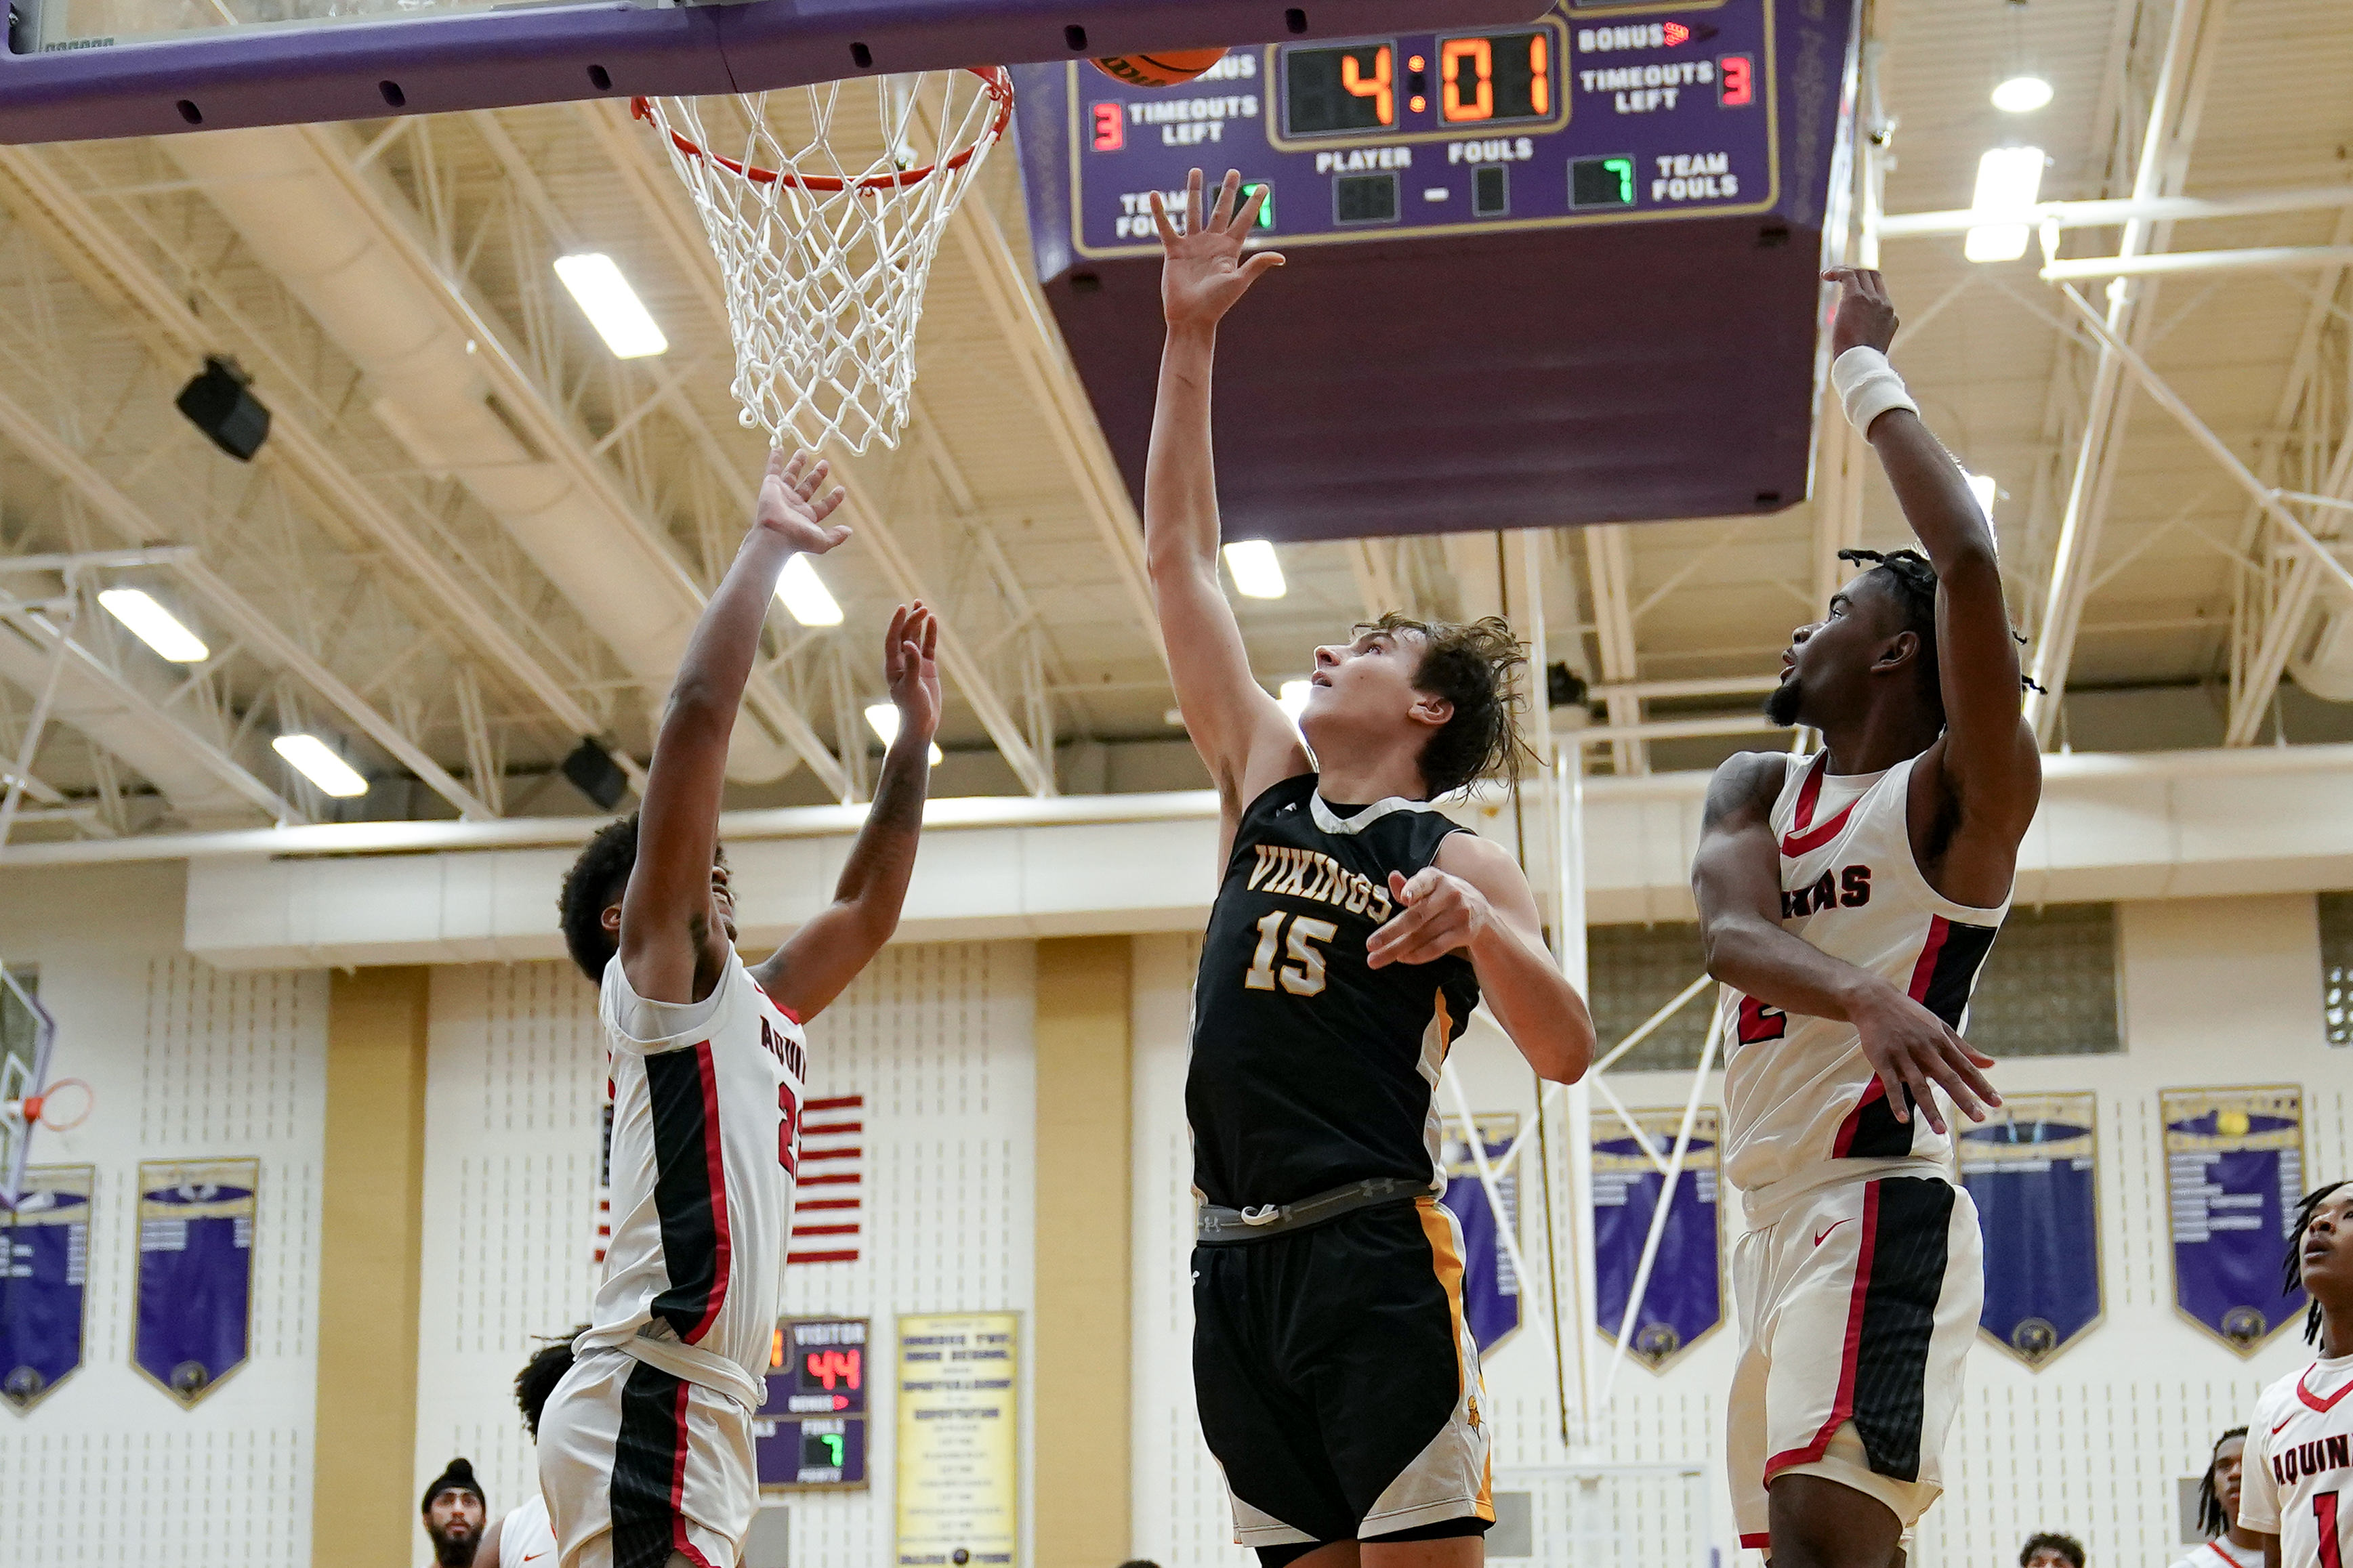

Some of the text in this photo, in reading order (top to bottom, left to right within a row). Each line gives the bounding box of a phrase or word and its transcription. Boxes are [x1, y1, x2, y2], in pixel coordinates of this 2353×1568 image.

[1578, 23, 1664, 53] BONUS
[1341, 34, 1549, 127] 4:01
[1579, 60, 1715, 93] TIMEOUTS
[1721, 57, 1751, 105] 3
[1128, 95, 1259, 125] TIMEOUTS
[1615, 87, 1679, 114] LEFT
[1094, 103, 1123, 151] 3
[1162, 120, 1225, 147] LEFT
[1316, 137, 1534, 174] PLAYER FOULS
[1656, 152, 1729, 178] TEAM
[1603, 158, 1632, 203] 7
[1652, 173, 1739, 202] FOULS
[1247, 844, 1394, 925] VIKINGS
[1245, 910, 1338, 998] 15
[807, 1349, 860, 1390] 44
[820, 1433, 844, 1467] 7
